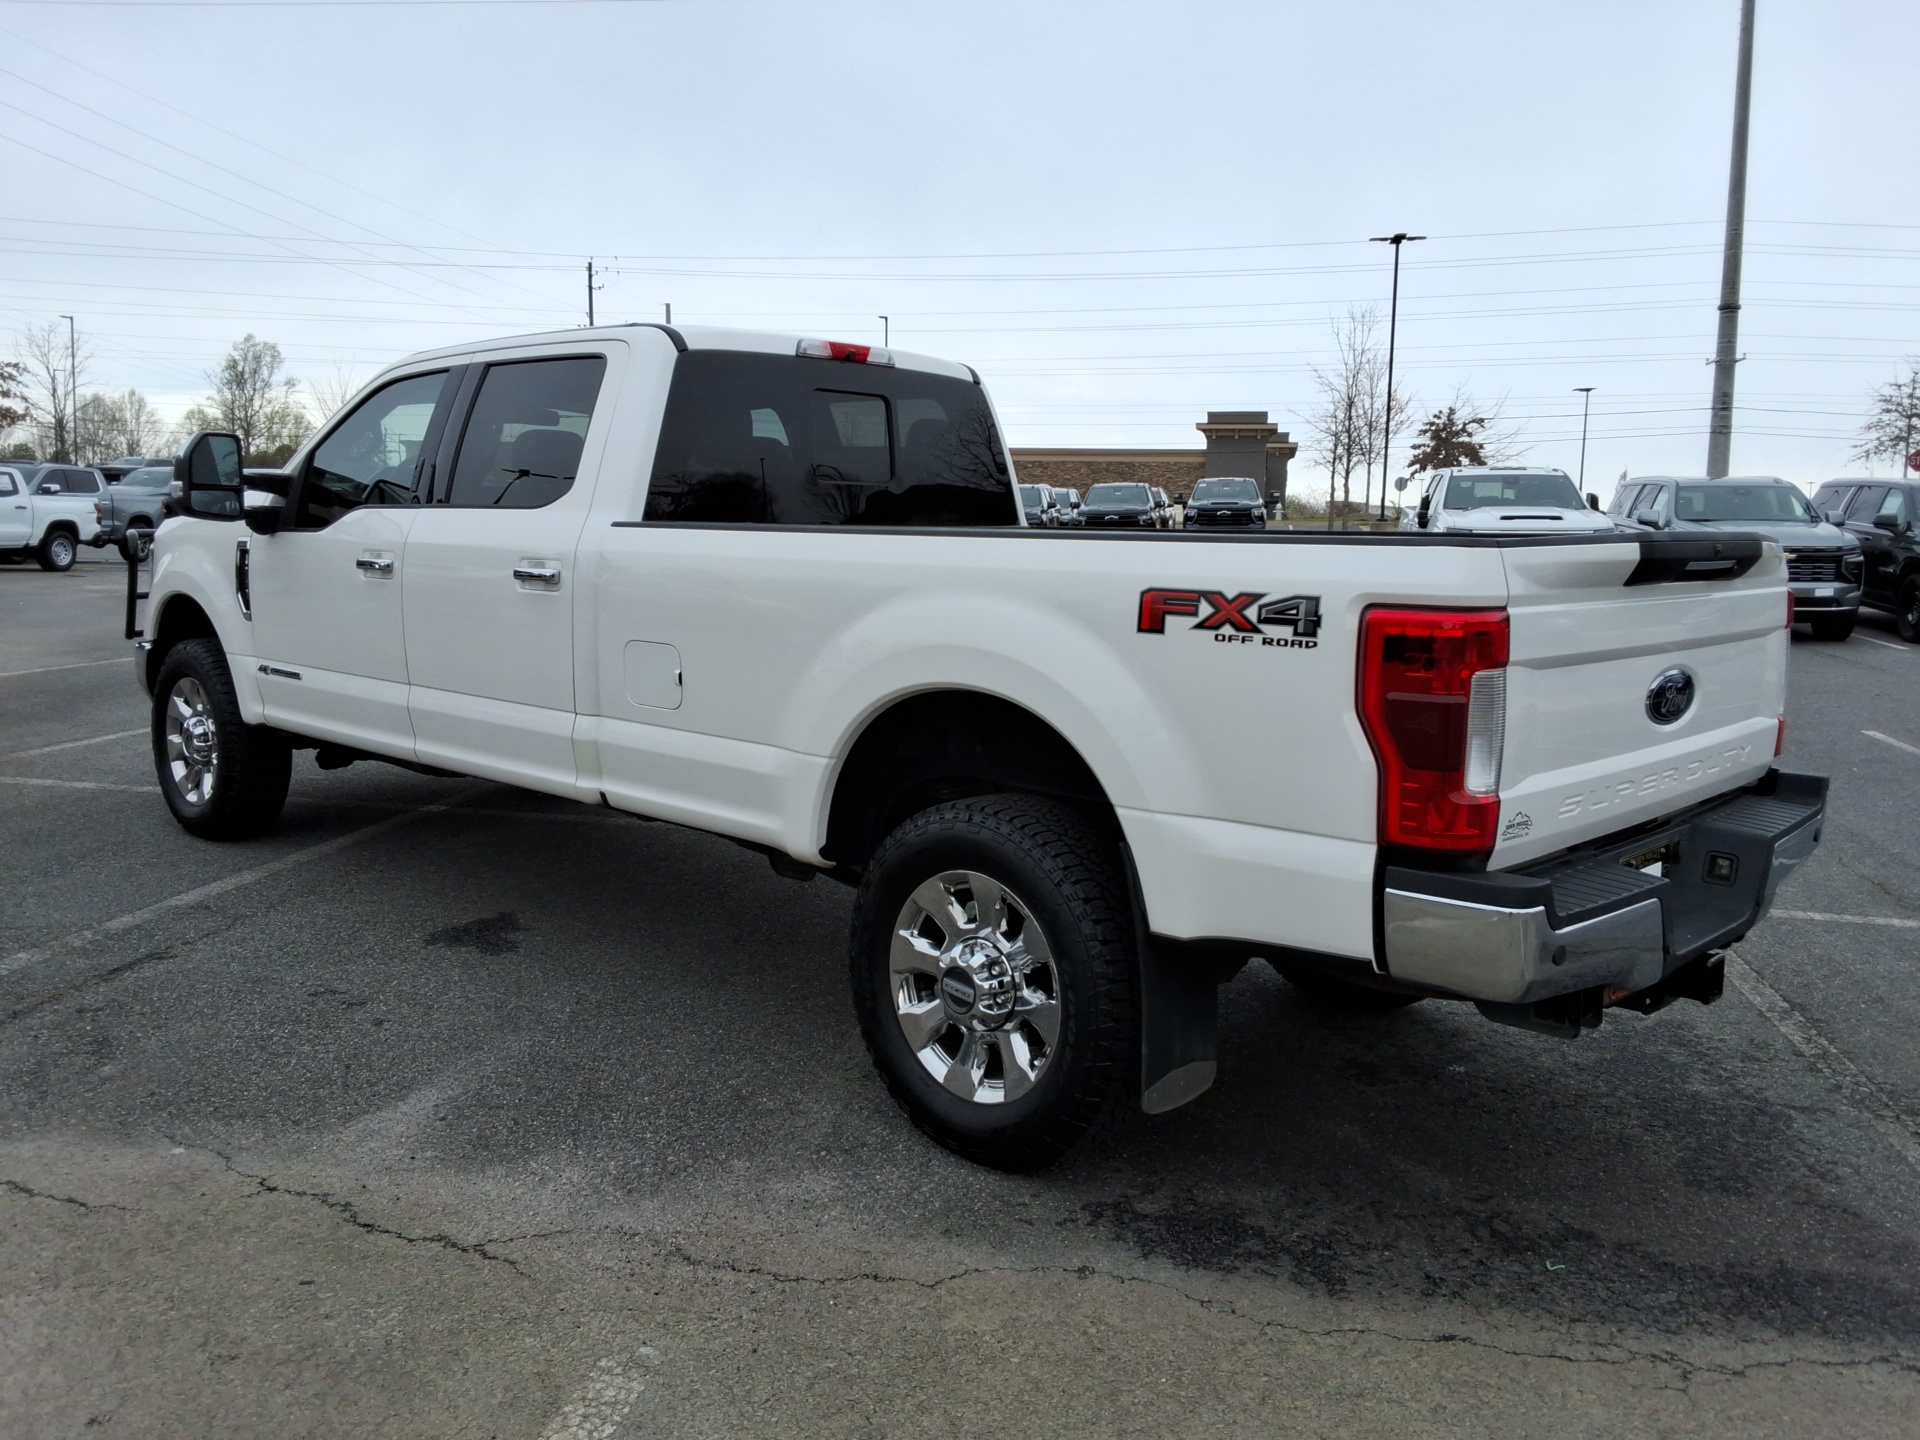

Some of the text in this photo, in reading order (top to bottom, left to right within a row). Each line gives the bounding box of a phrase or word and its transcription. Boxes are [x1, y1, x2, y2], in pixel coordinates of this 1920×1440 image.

[1136, 586, 1322, 638] FX4
[1214, 633, 1318, 649] OFF ROAD
[1558, 744, 1752, 819] SUPER DUTY
[944, 983, 970, 998] FORD
